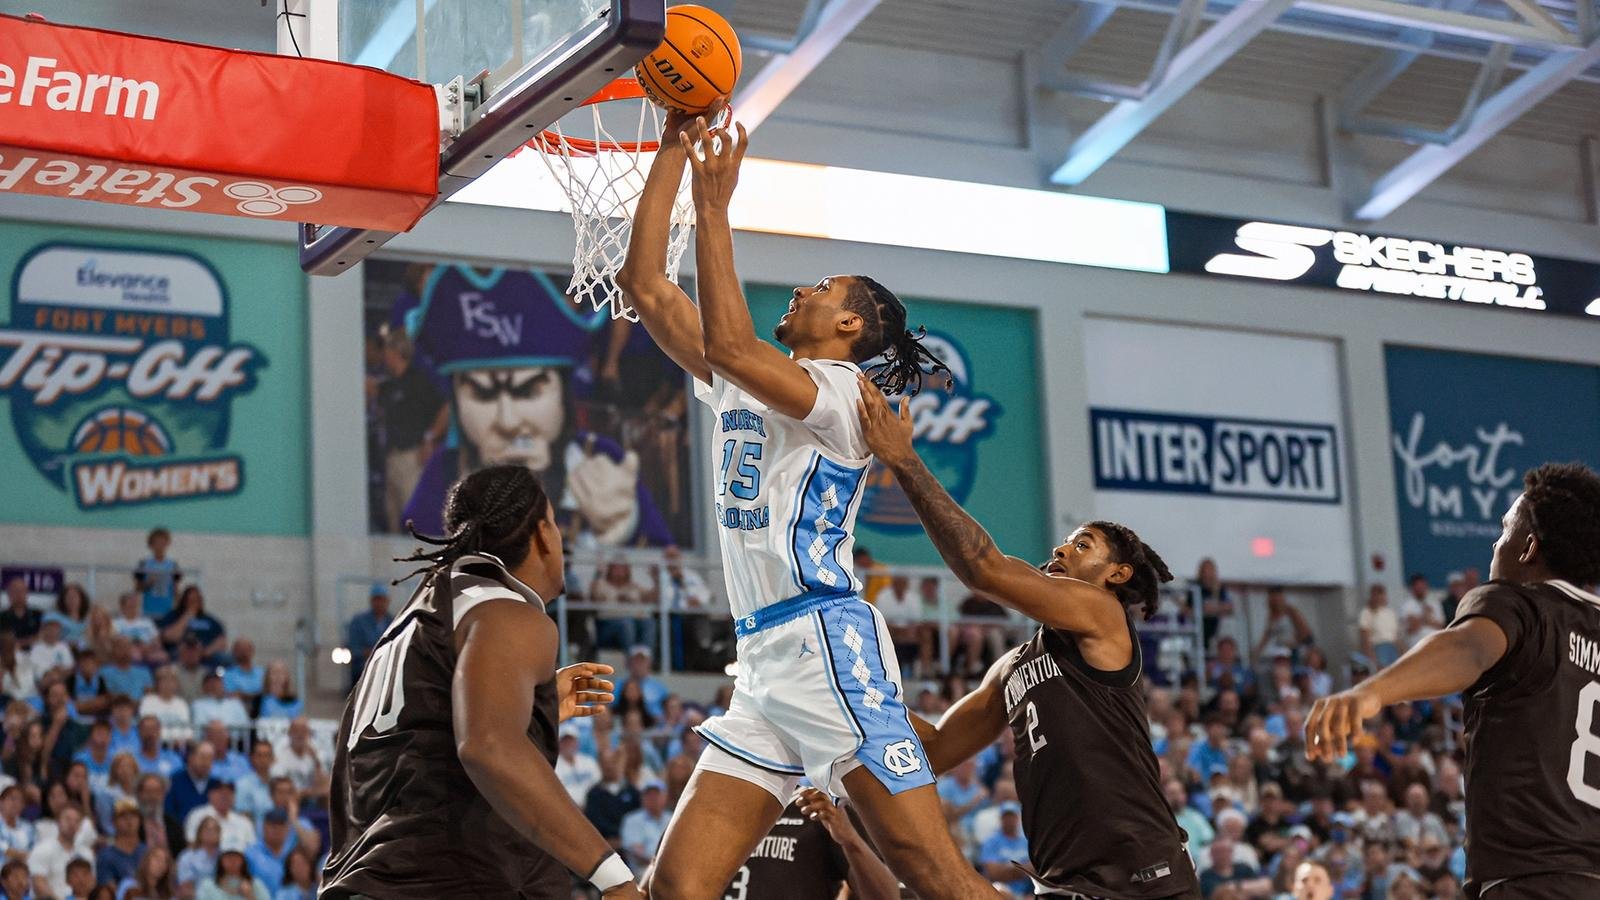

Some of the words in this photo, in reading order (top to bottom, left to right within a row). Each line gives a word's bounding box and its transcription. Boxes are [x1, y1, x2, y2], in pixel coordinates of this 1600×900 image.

[1332, 231, 1537, 286] SKECHERS
[1336, 264, 1547, 311] BASKETBALL
[35, 308, 104, 332] FORT
[115, 313, 205, 339] MYERS
[459, 291, 523, 346] FSW
[0, 330, 252, 404] Tip-Off
[718, 438, 762, 501] 15
[1393, 411, 1524, 508] fort
[1026, 701, 1048, 753] 2
